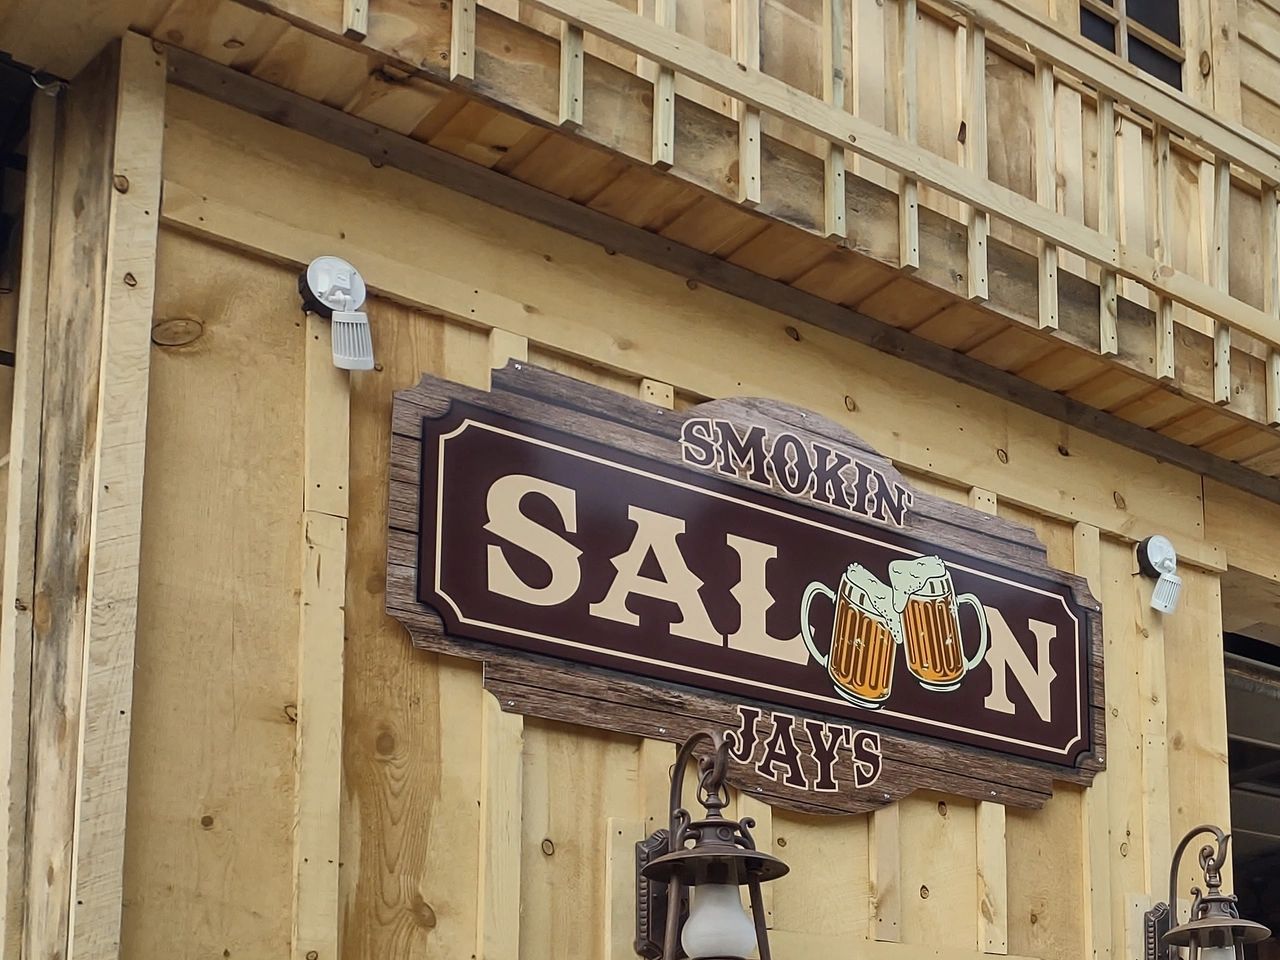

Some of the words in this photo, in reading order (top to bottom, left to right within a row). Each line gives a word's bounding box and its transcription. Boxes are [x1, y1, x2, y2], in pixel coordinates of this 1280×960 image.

[679, 418, 912, 527] SMOKIN'
[483, 474, 1058, 723] SALN
[724, 705, 882, 792] JAY'S
